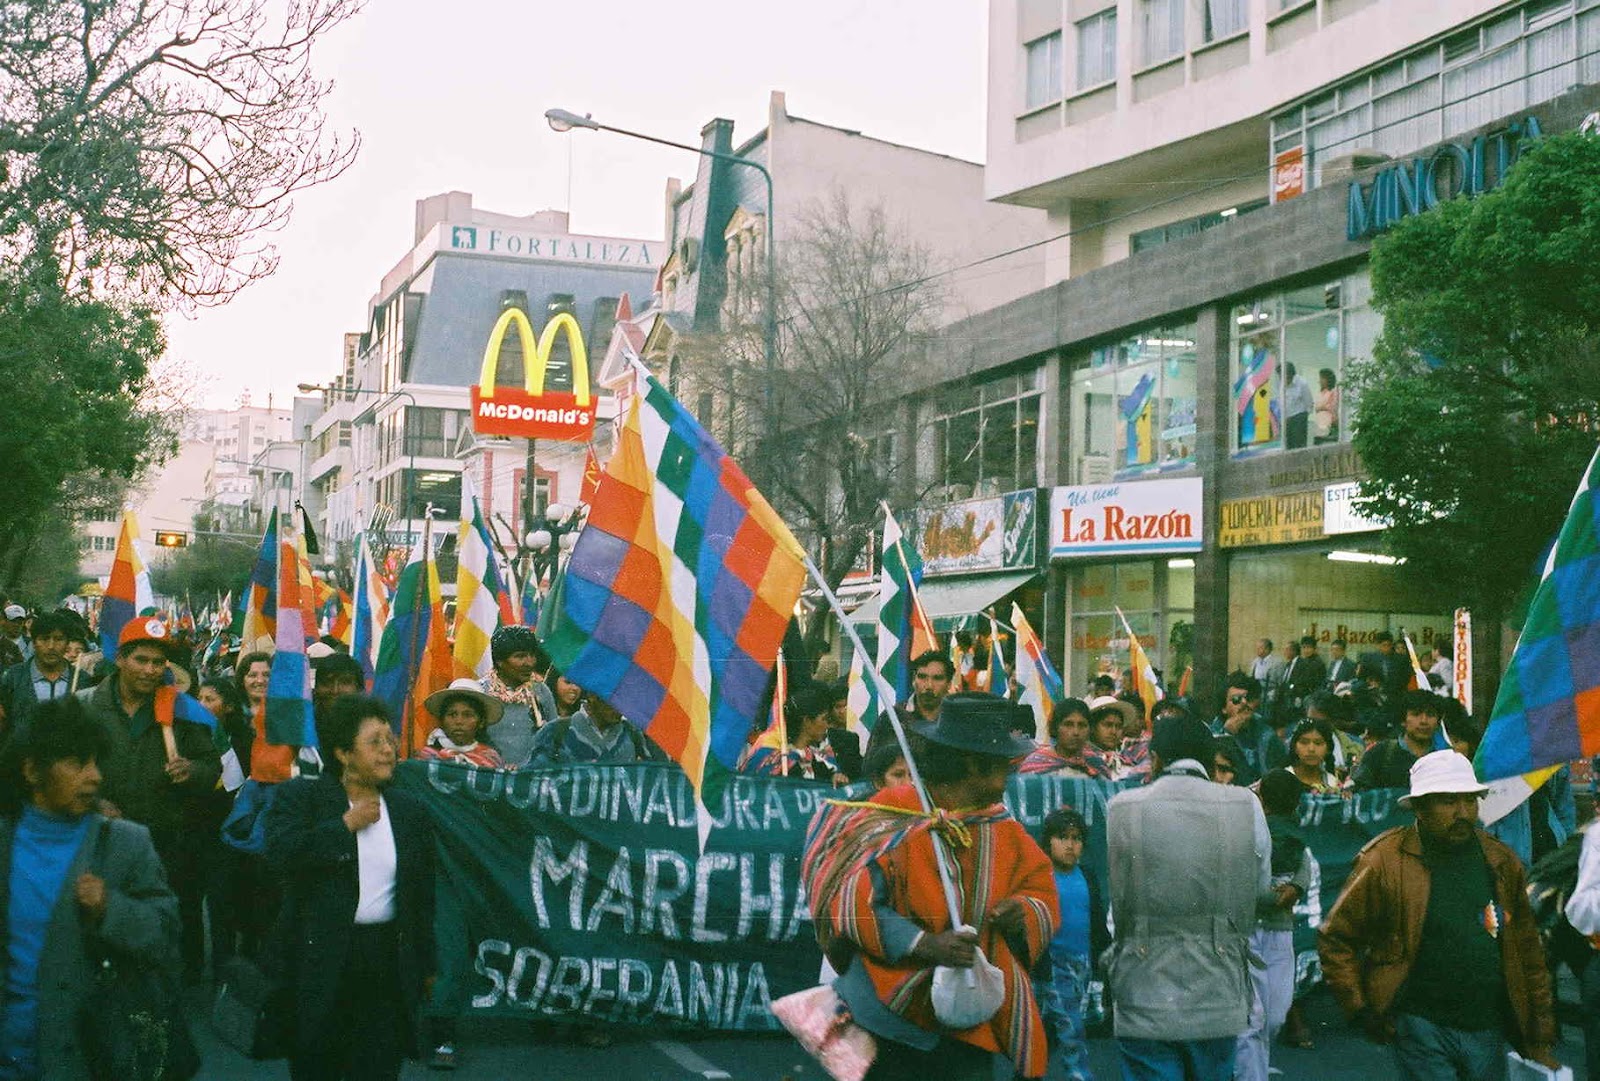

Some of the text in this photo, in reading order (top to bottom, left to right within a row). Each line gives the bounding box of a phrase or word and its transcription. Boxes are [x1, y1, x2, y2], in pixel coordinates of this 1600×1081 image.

[488, 230, 651, 264] FORTALEZA
[479, 402, 590, 425] McDonald's
[1062, 505, 1193, 543] La Razón
[1275, 490, 1324, 526] PARAIS
[1337, 624, 1377, 645] Razó
[472, 940, 779, 1031] SOBERANIA
